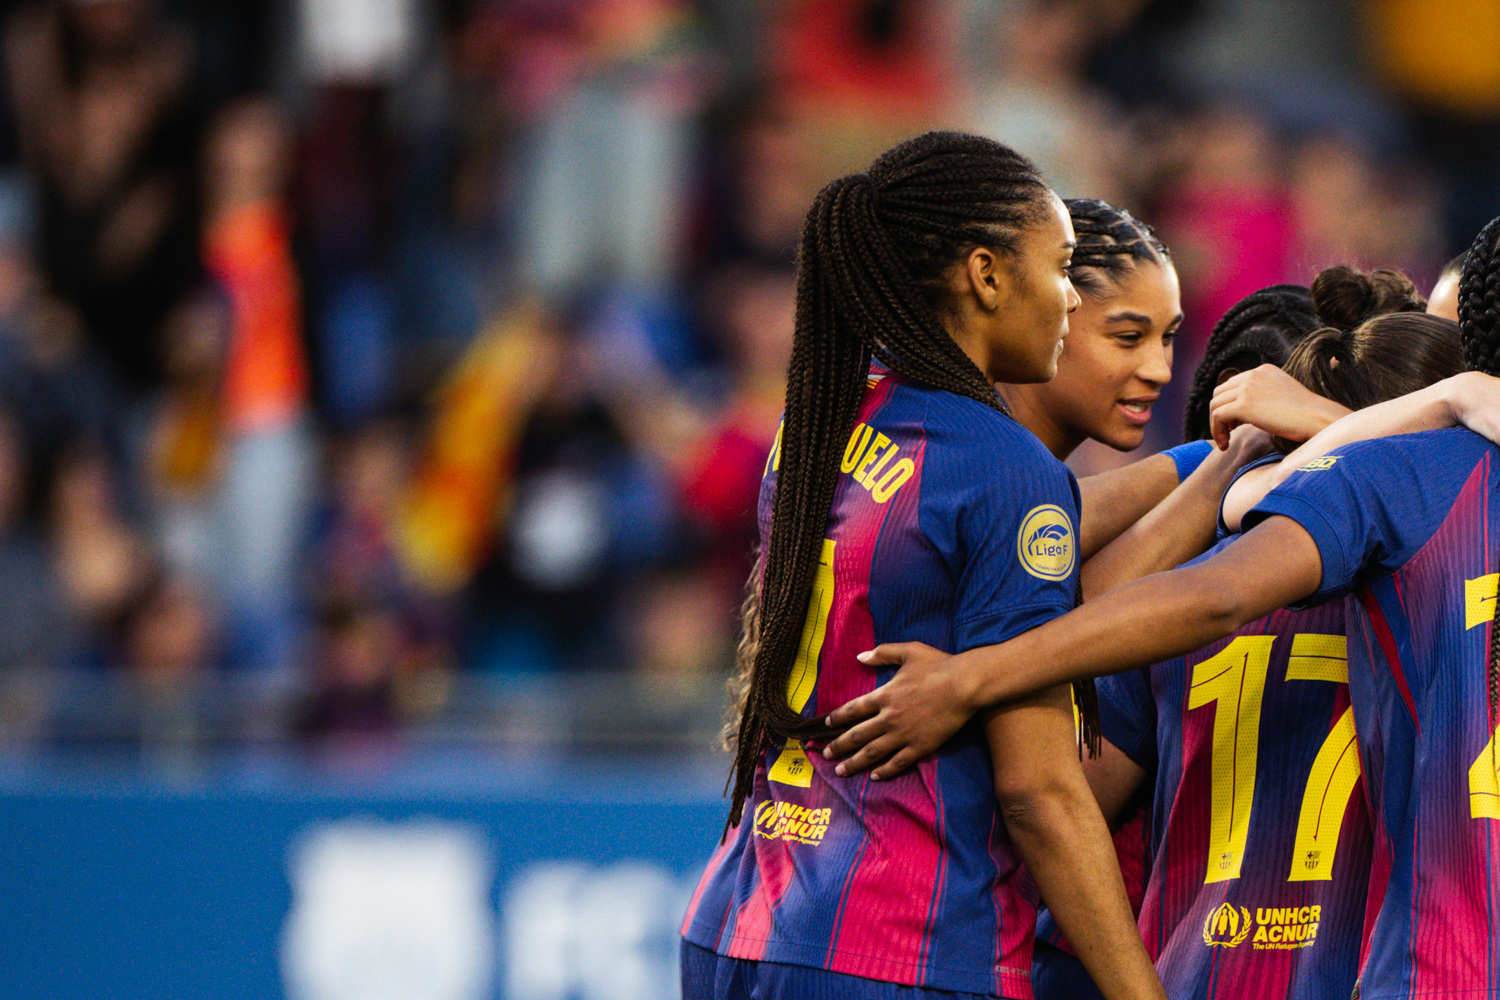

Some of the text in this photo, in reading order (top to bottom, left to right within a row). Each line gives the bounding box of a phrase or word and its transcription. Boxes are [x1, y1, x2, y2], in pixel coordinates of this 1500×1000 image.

[840, 422, 915, 504] UELO
[1188, 634, 1361, 883] 17
[1252, 922, 1319, 943] ACNUR
[1255, 905, 1322, 926] UNHCR
